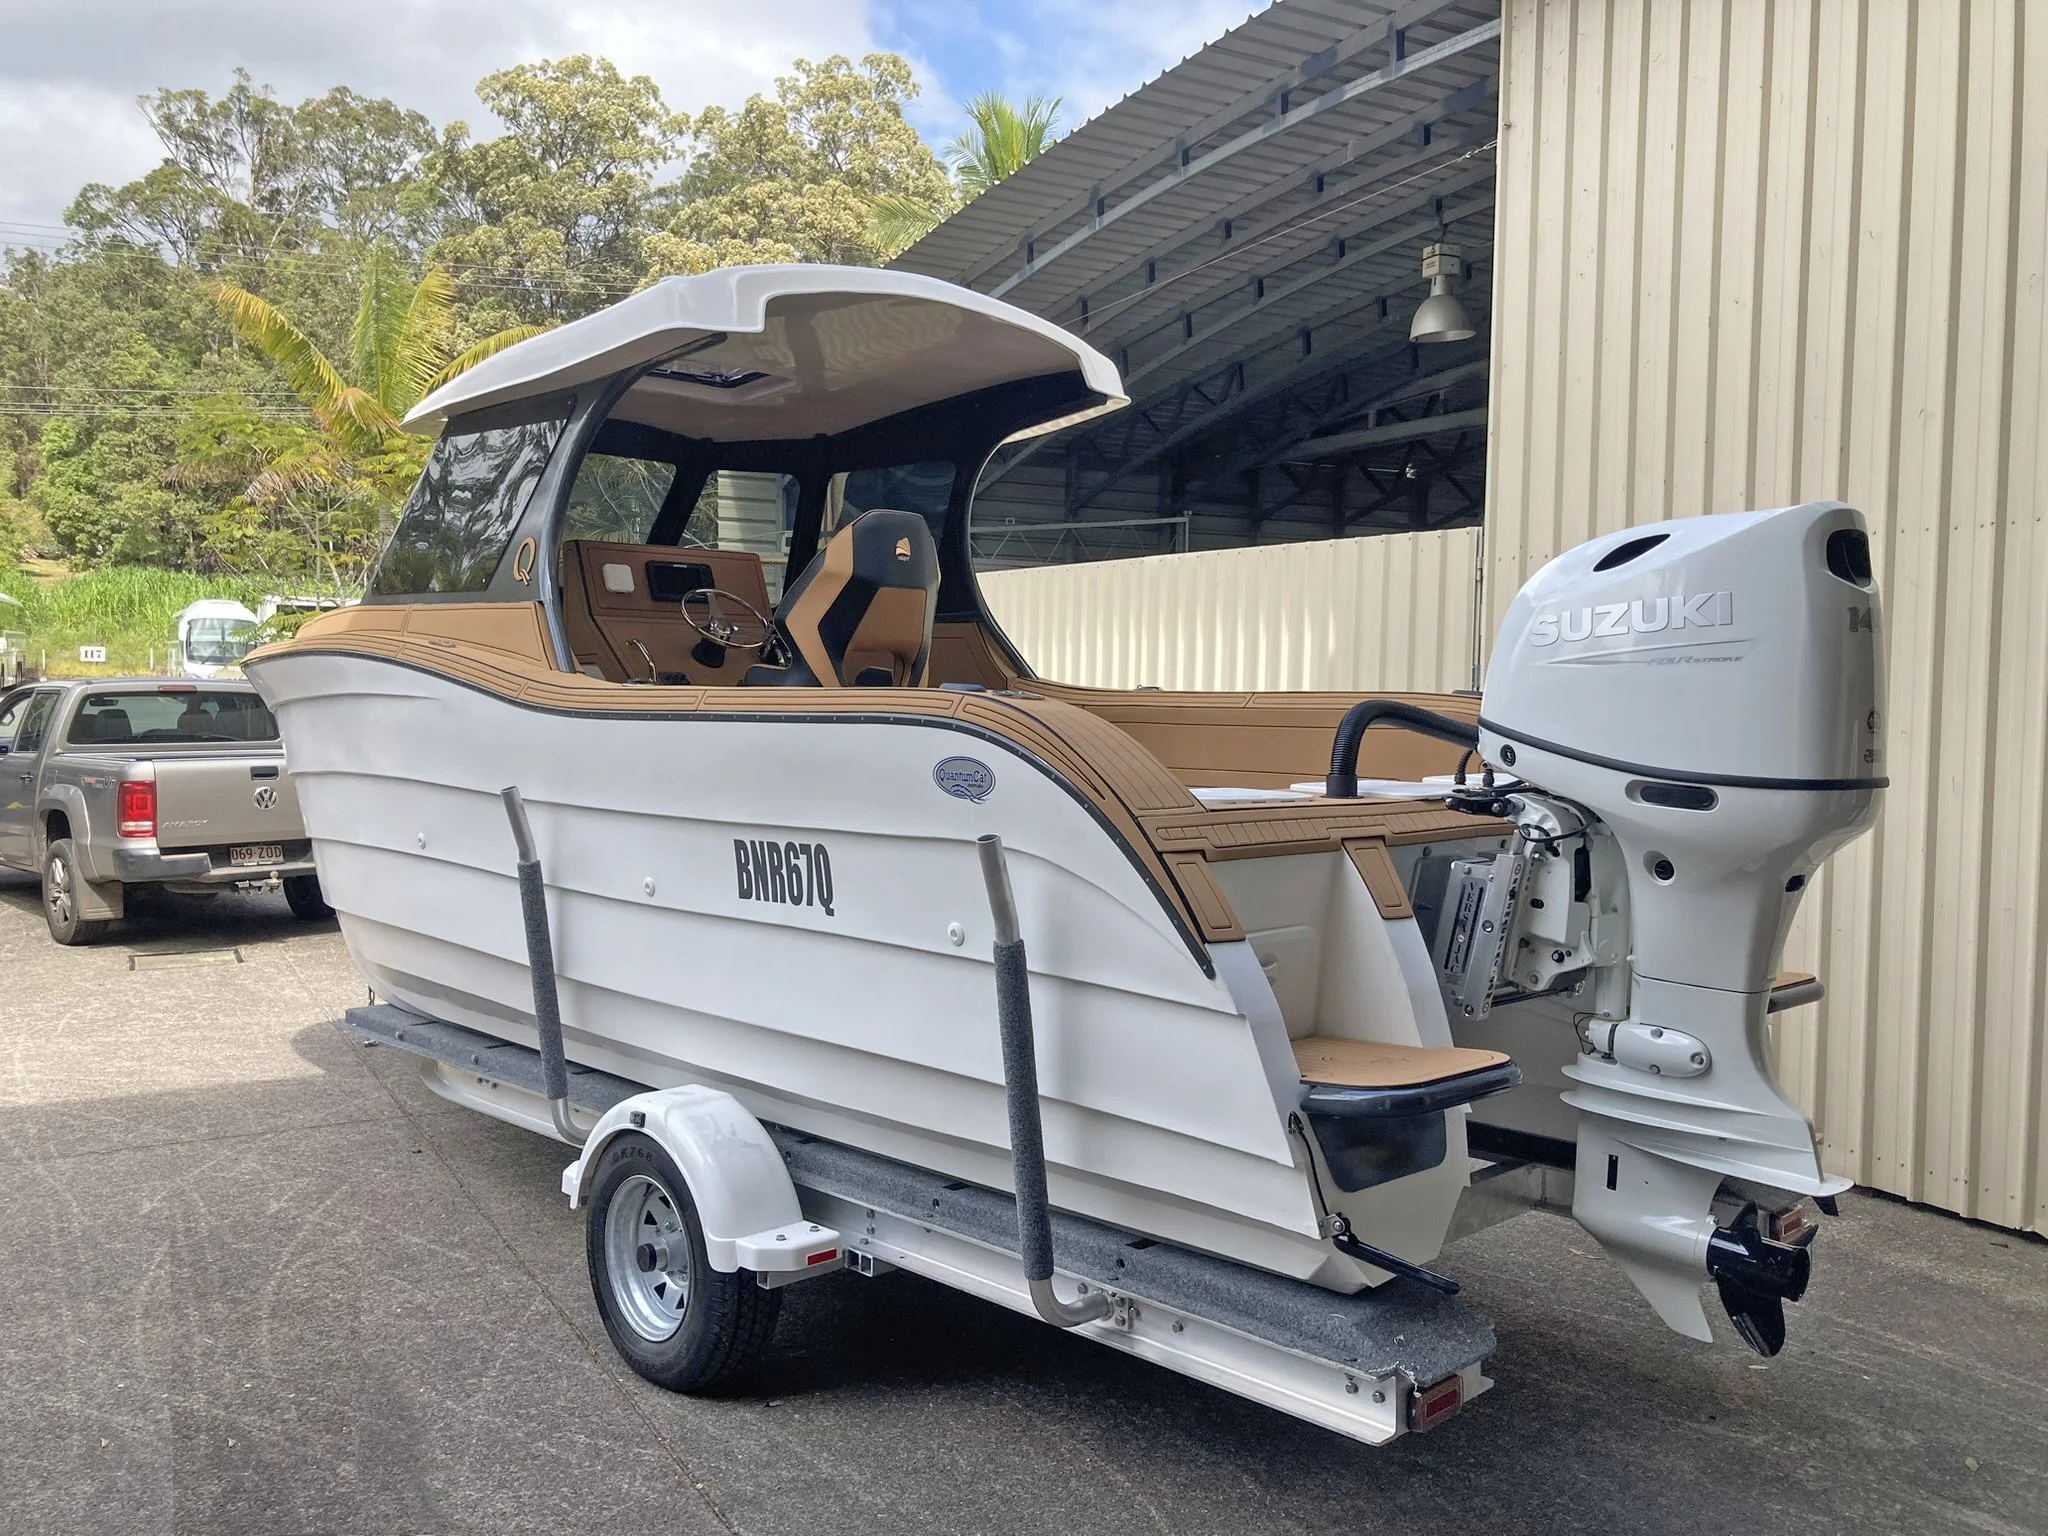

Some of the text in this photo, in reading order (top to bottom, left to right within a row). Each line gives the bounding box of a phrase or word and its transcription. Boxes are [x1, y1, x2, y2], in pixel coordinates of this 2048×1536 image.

[1529, 591, 1733, 647] SUZUKI
[84, 649, 102, 659] 117
[939, 768, 987, 783] QuantumCat
[733, 839, 835, 917] BNR67Q
